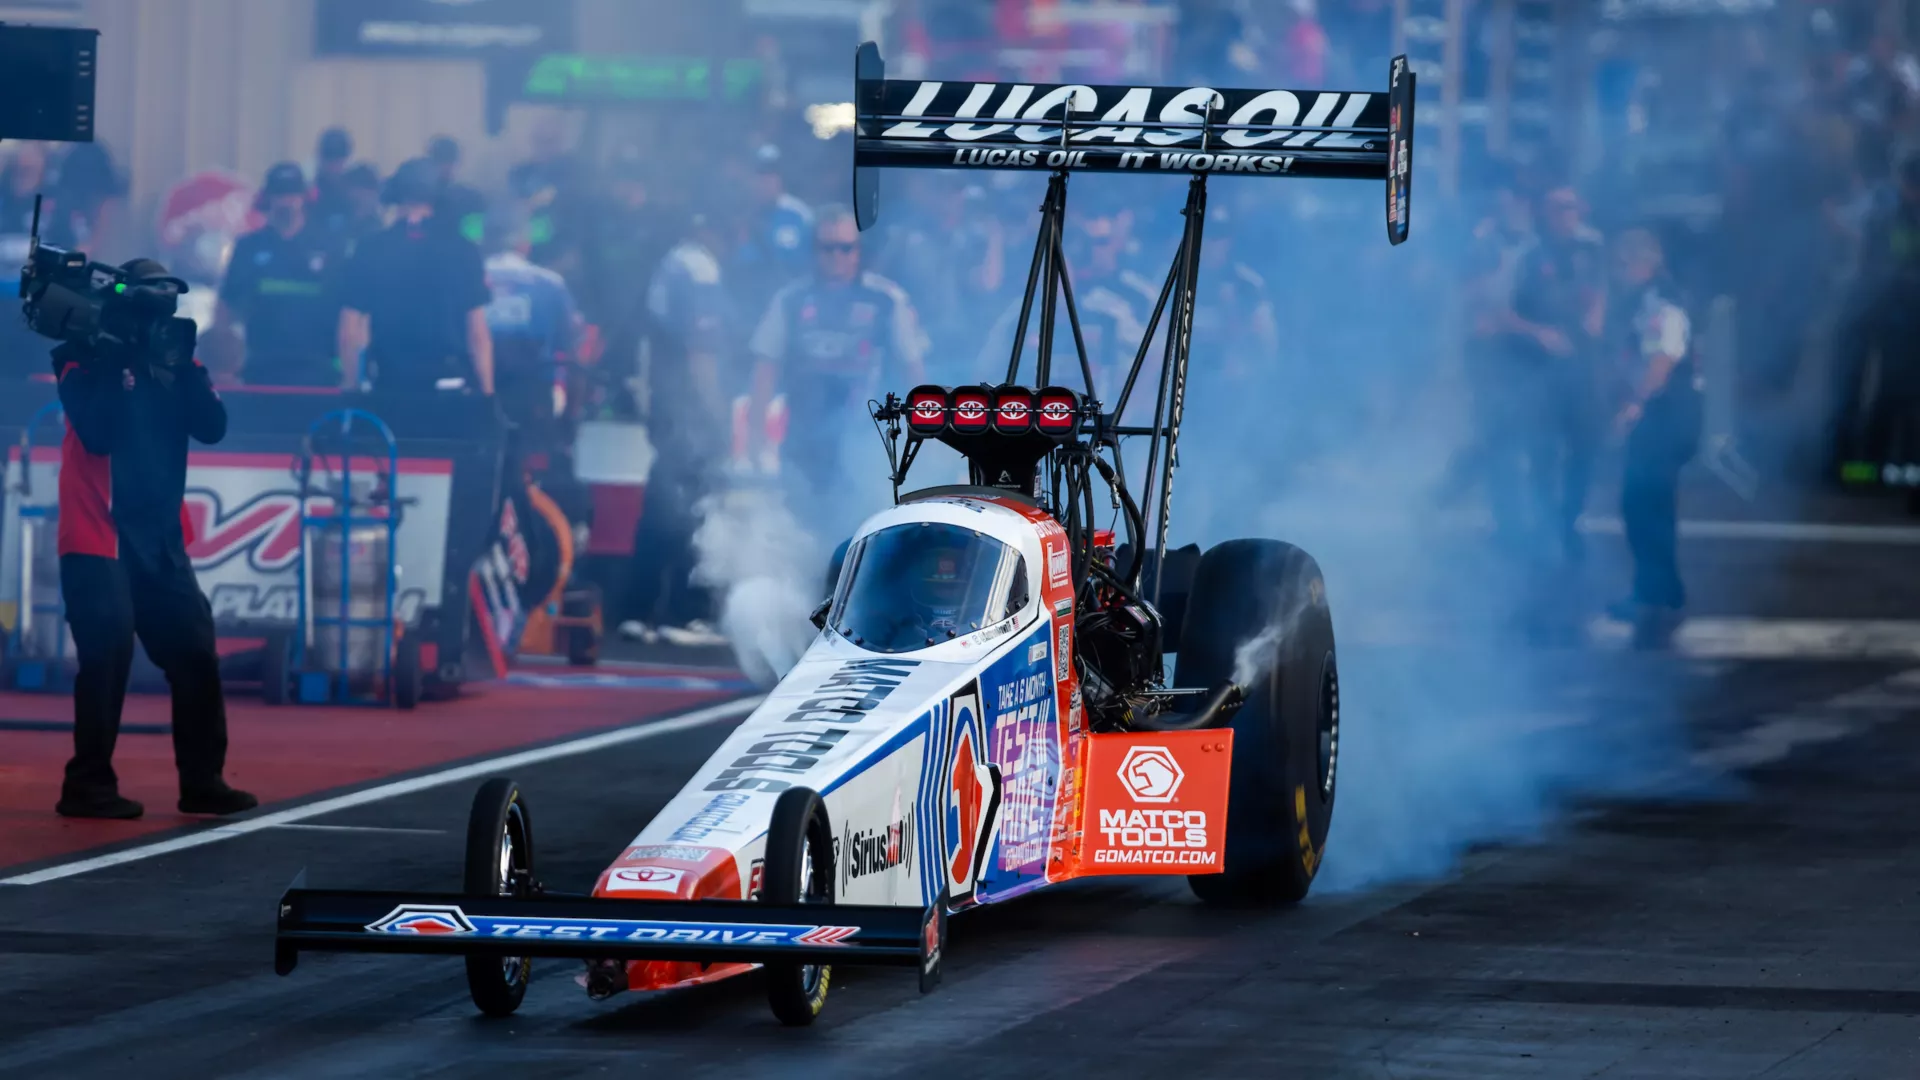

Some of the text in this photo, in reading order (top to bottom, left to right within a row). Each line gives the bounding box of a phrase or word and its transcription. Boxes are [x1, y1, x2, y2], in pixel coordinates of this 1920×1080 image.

[880, 81, 1372, 148] LUCAS OIL
[952, 148, 1088, 168] LUCAS OIL
[1117, 152, 1295, 173] IT WORKS!
[783, 658, 923, 724] MATCO
[998, 671, 1047, 711] TAKE A 6 MONTH
[996, 703, 1039, 777] TEST
[703, 728, 850, 793] TOOLS
[1099, 809, 1206, 828] MATCO
[1100, 827, 1207, 848] TOOLS
[1094, 849, 1216, 865] GOMATCO.COM
[491, 923, 789, 943] TEST DRIVE
